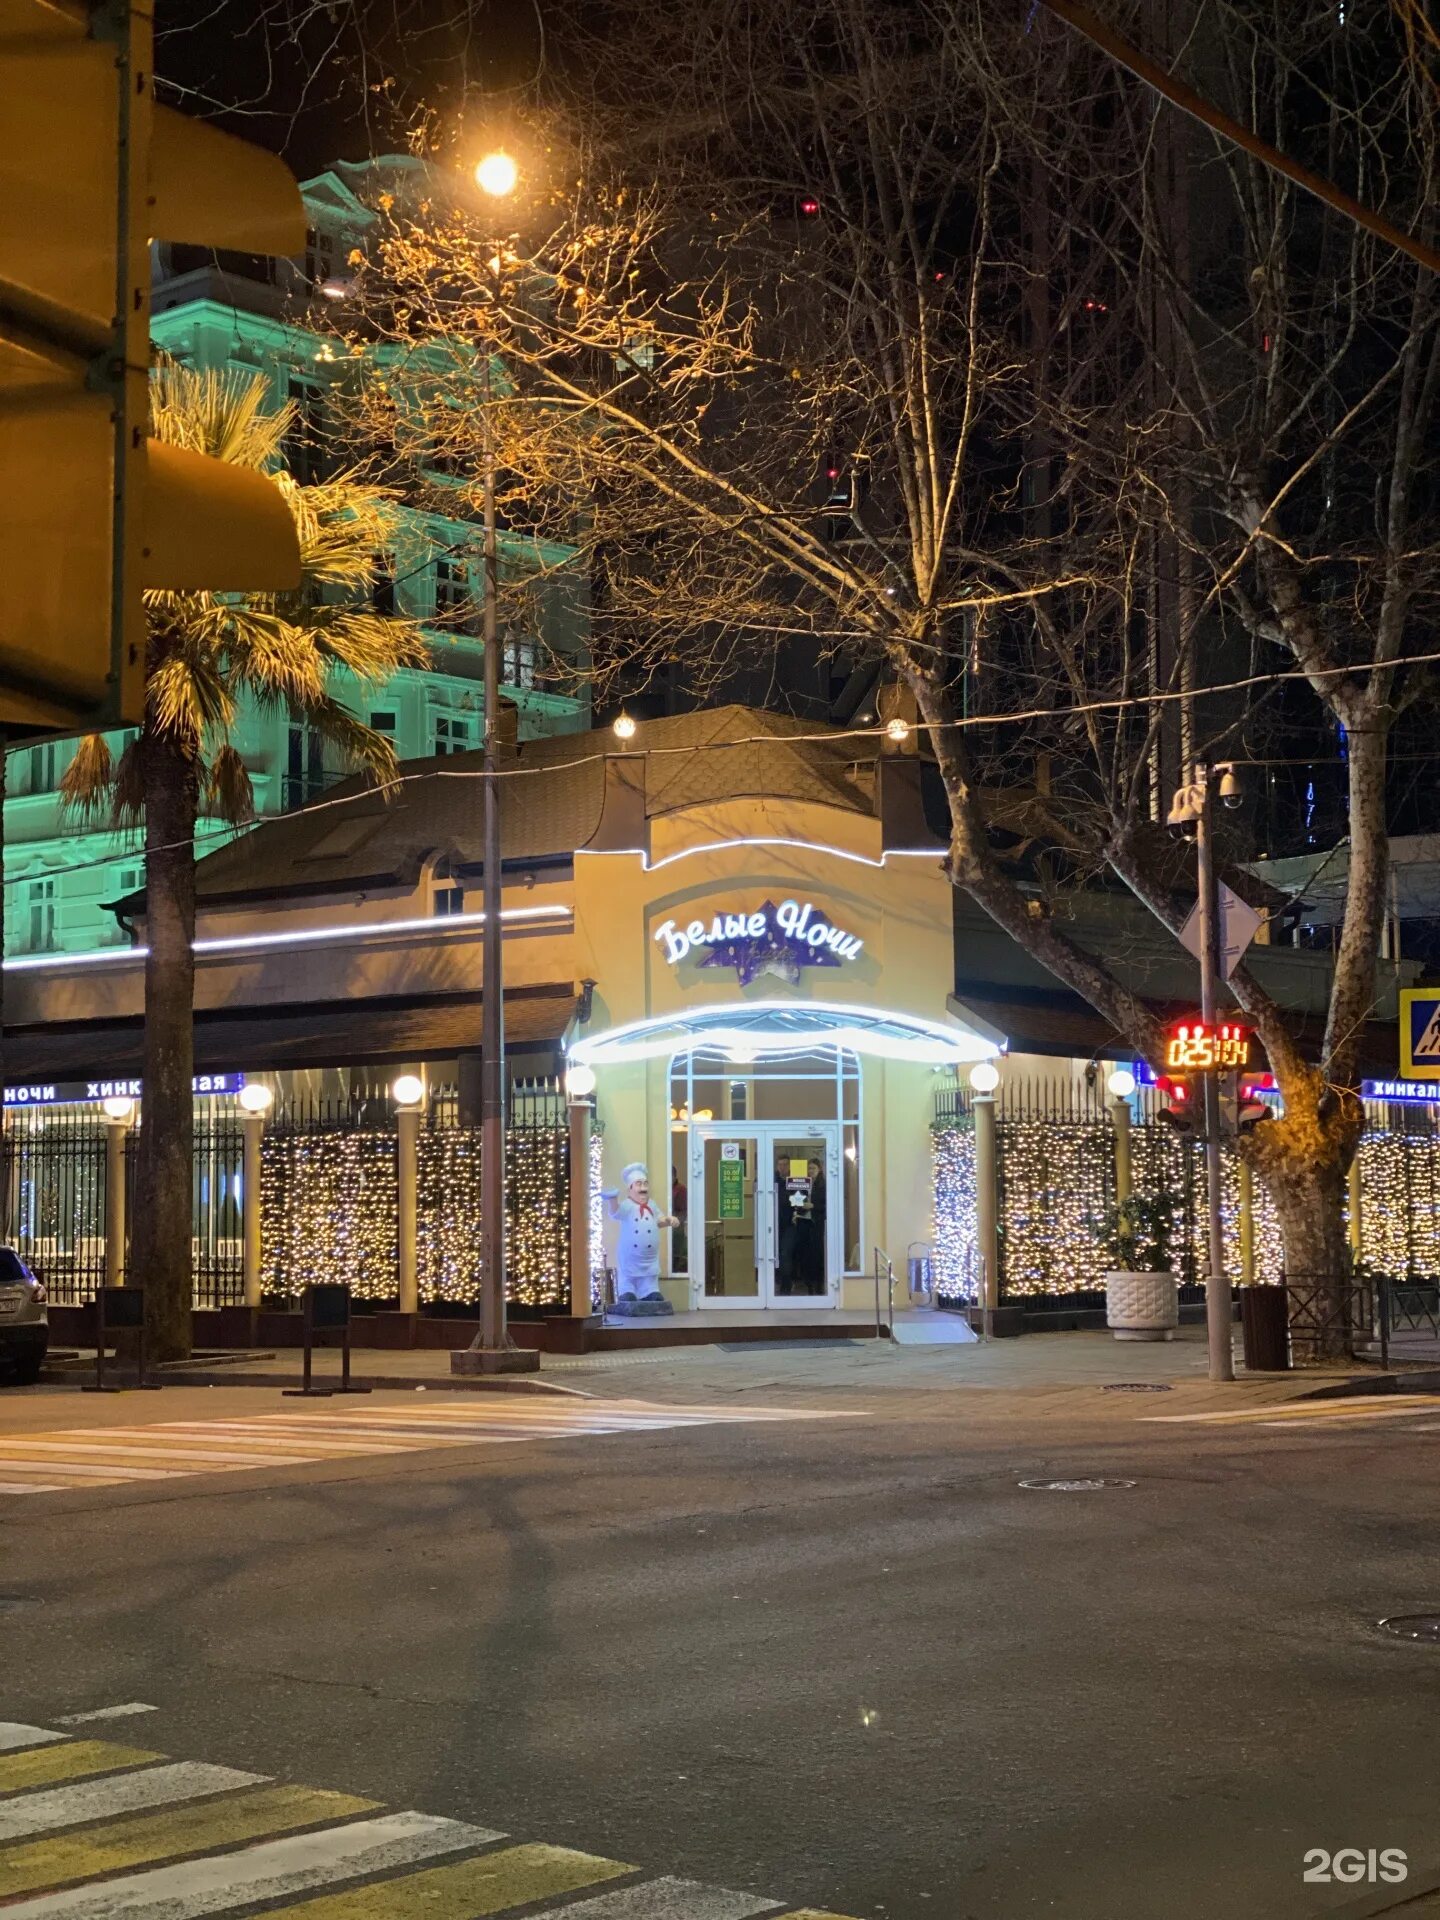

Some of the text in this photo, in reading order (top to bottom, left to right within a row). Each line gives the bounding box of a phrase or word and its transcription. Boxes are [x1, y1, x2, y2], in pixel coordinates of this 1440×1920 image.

[654, 900, 865, 964] Белые Ночи
[87, 1075, 226, 1098] хинкая
[1374, 1081, 1440, 1098] хинкал
